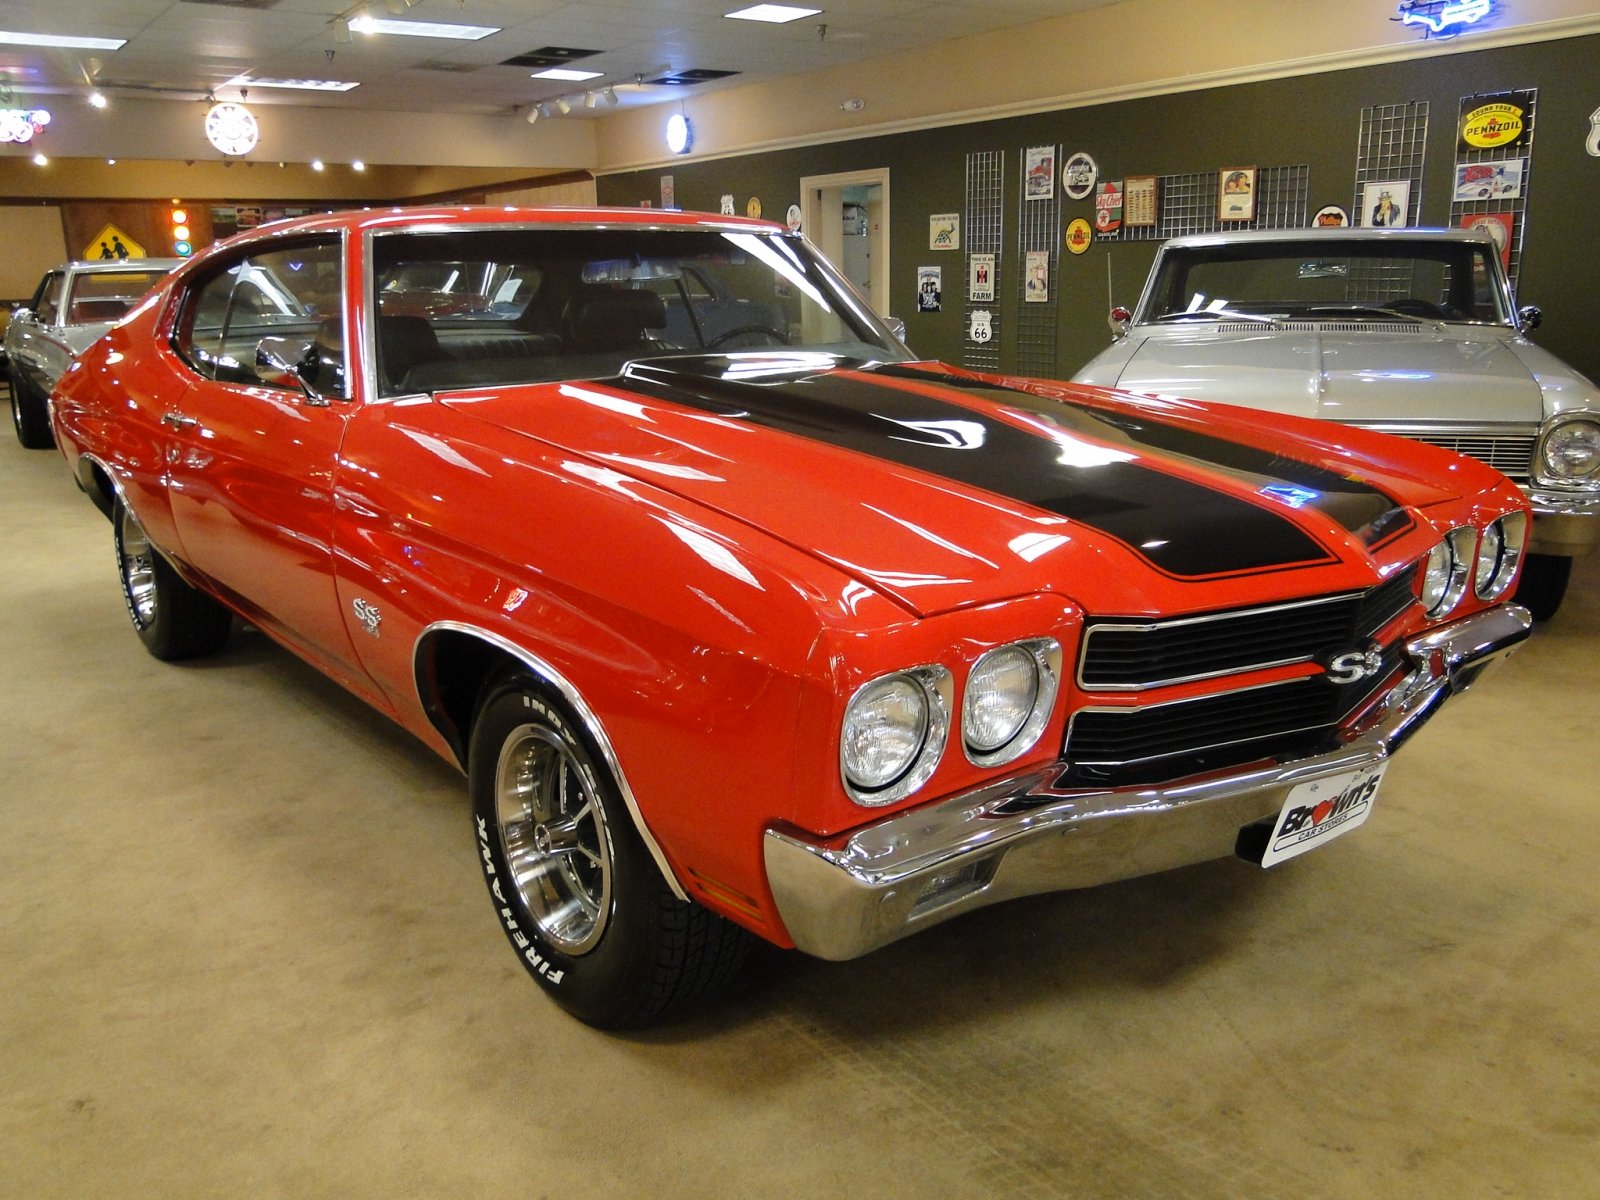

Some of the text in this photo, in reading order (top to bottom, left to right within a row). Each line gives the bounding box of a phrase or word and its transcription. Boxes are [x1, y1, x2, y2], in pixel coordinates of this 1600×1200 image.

[1472, 105, 1493, 117] SOUND
[1495, 104, 1512, 112] YOUR
[1466, 121, 1521, 136] PENNZOIL
[972, 292, 992, 300] FARM
[974, 328, 988, 339] 66
[1298, 813, 1349, 841] CAR STORES
[476, 814, 565, 985] FIREHAWK
